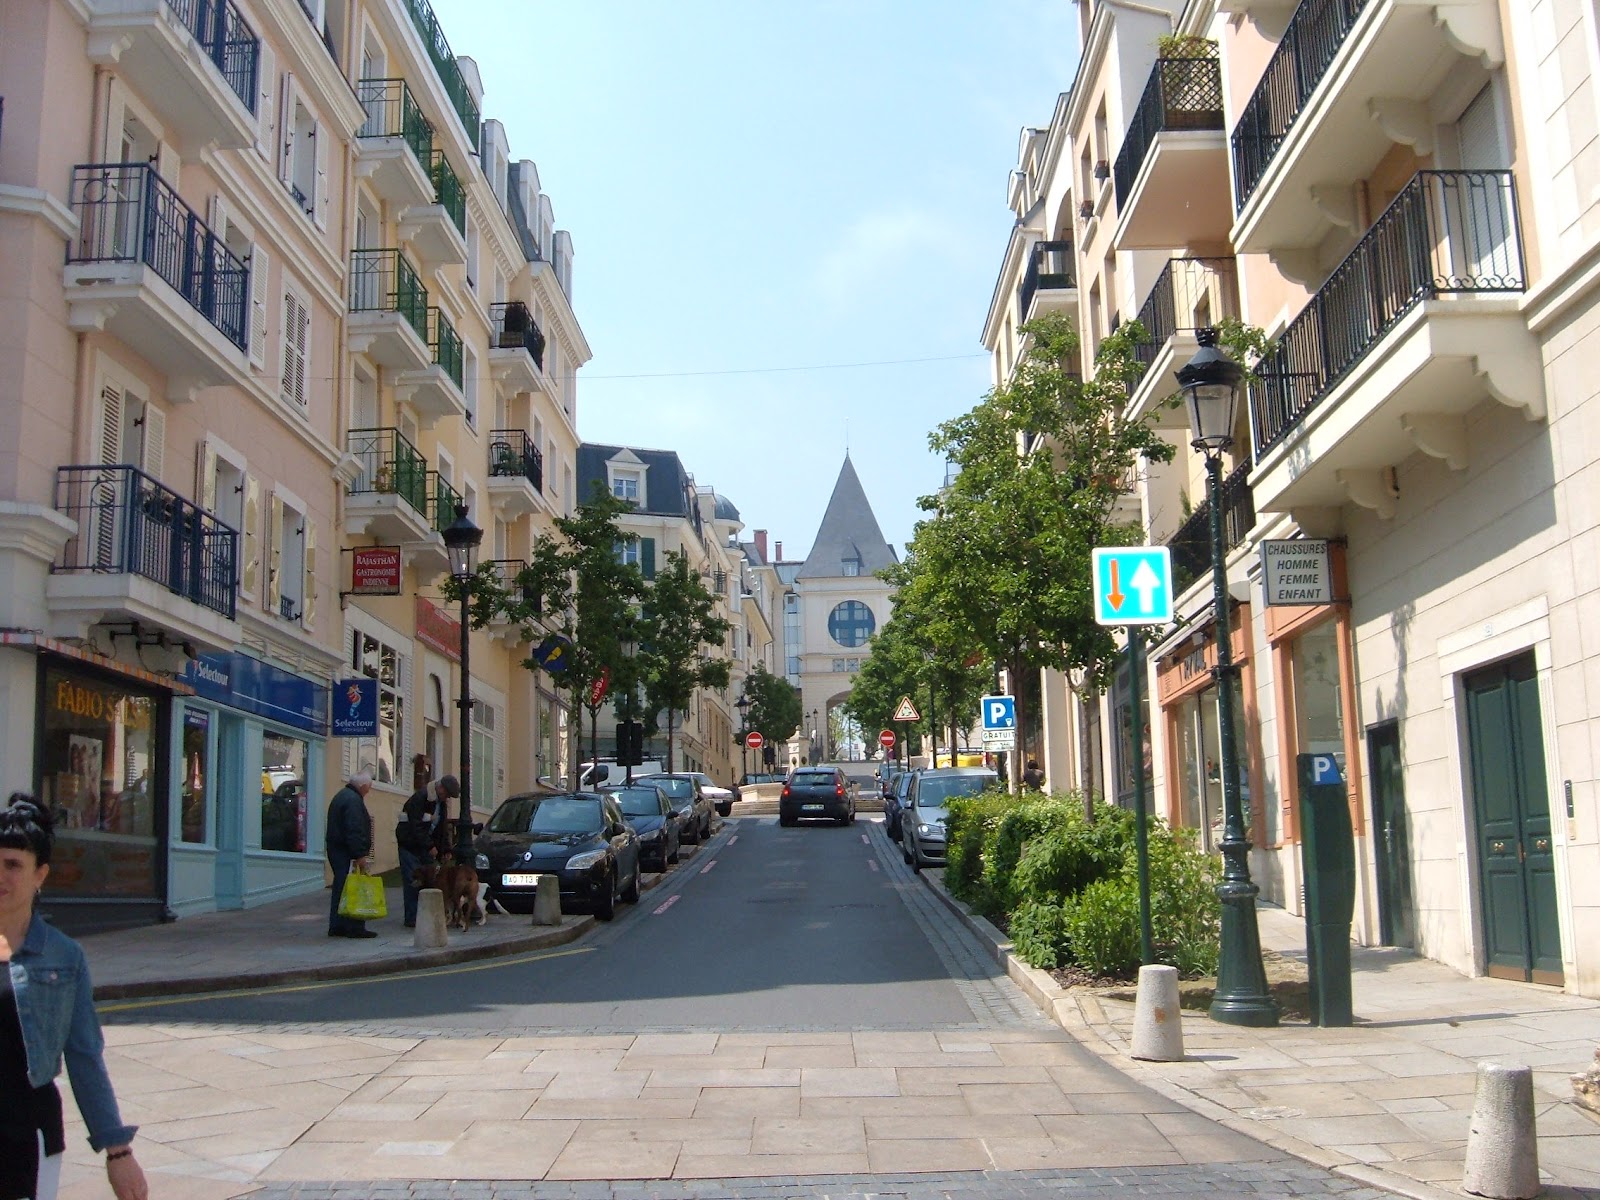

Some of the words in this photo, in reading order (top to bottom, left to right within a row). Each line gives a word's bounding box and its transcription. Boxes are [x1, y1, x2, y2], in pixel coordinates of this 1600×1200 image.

[1268, 543, 1327, 555] CHAUSSURES
[356, 554, 397, 565] RAJASTHAN
[1277, 559, 1319, 570] HOMME
[356, 568, 396, 576] GASTRONOMIE
[362, 578, 389, 586] INDIENNE
[1278, 574, 1319, 585] FEMME
[1278, 588, 1322, 600] ENFANT
[198, 660, 229, 686] Selectour
[57, 682, 102, 719] FABIO
[990, 702, 1006, 724] P
[334, 718, 374, 727] Selectour
[1313, 756, 1331, 782] P
